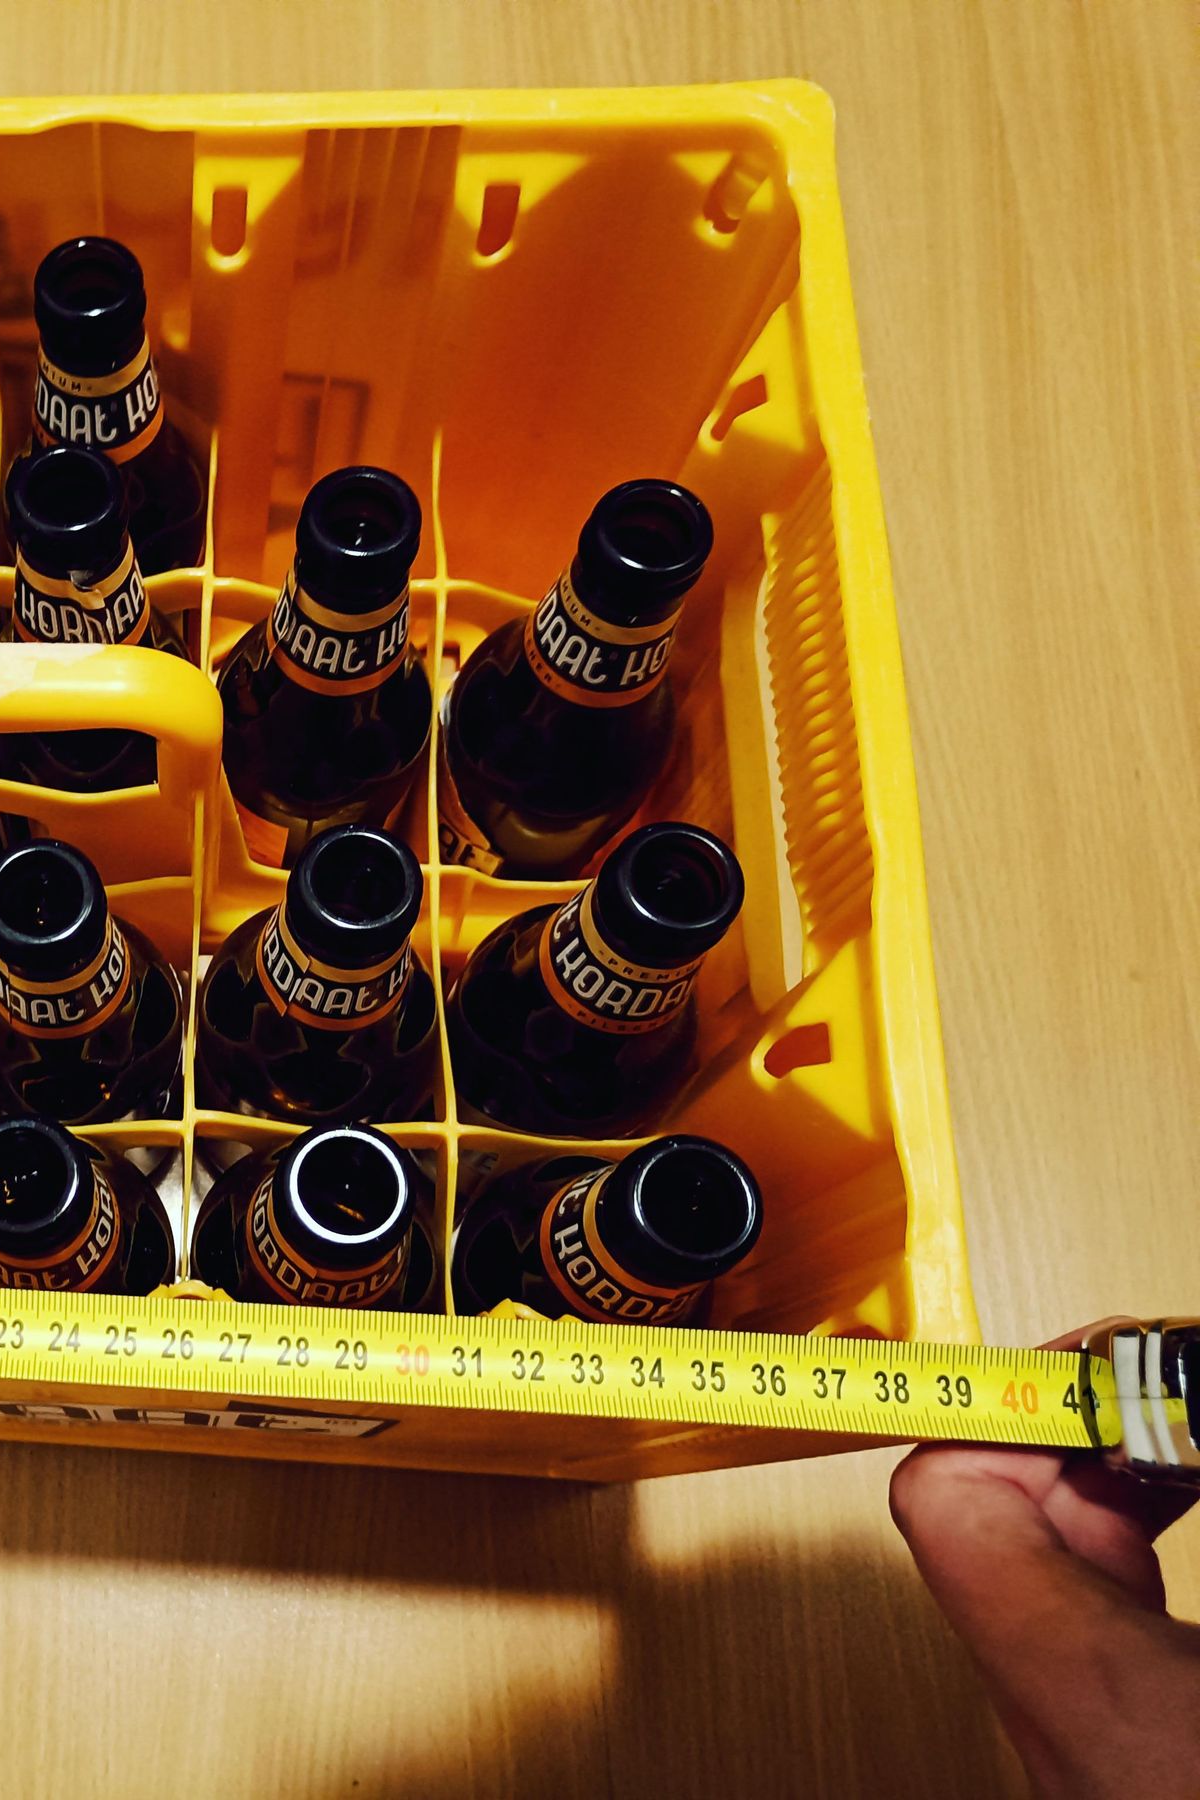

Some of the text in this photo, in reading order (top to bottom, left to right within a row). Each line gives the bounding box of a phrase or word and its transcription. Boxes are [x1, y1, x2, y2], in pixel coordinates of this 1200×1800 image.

[42, 362, 81, 392] MIUM
[563, 581, 590, 627] MIUM
[48, 1321, 81, 1354] 24
[104, 1324, 138, 1357] 25
[161, 1327, 195, 1360] 26
[218, 1331, 253, 1363] 27
[276, 1334, 311, 1368] 28
[334, 1338, 369, 1371] 29
[395, 1342, 431, 1377] 30
[451, 1346, 483, 1379] 31
[511, 1348, 546, 1382] 32
[570, 1352, 605, 1385] 33
[629, 1355, 666, 1389] 34
[690, 1359, 726, 1393] 35
[750, 1362, 787, 1397] 36
[811, 1367, 848, 1401] 37
[872, 1370, 911, 1405] 38
[934, 1374, 973, 1409] 39
[1000, 1379, 1040, 1416] 40
